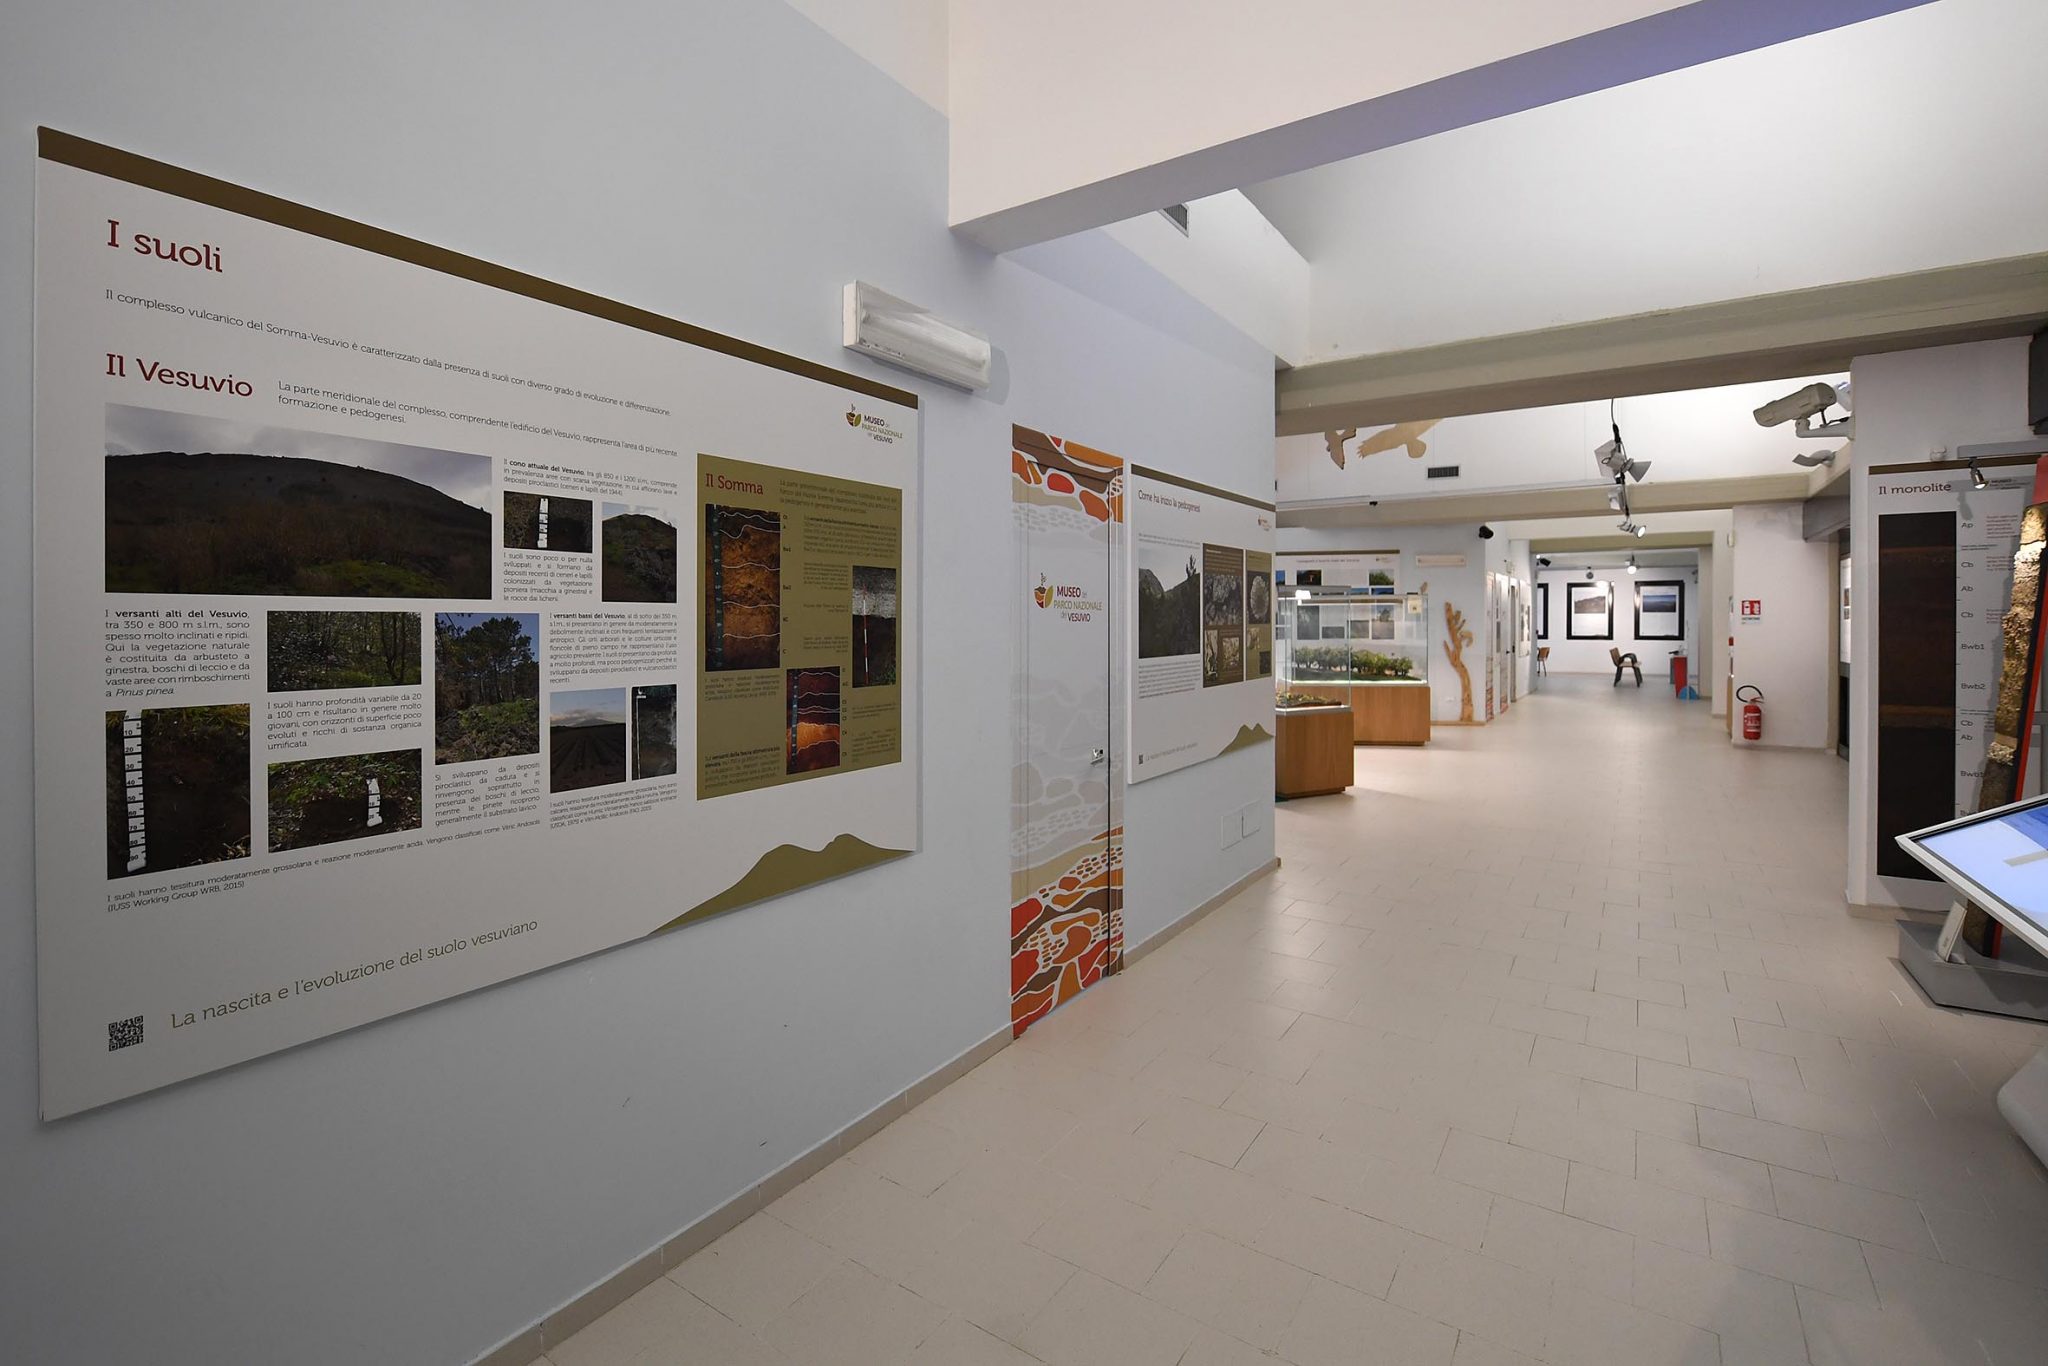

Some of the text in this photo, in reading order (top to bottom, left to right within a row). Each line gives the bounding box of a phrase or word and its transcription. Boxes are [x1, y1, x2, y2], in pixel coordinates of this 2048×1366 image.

[107, 220, 223, 273] I suoli
[106, 289, 113, 300] Il
[118, 294, 184, 314] complesso
[189, 309, 243, 326] vulcanico
[247, 320, 263, 330] del
[267, 324, 349, 348] Somma-Vesuvio
[352, 342, 358, 351] è
[361, 346, 420, 363] caratterizzato
[423, 358, 442, 368] dalla
[445, 363, 480, 376] presenza
[492, 374, 508, 382] suoli
[528, 380, 552, 391] diverso
[554, 387, 574, 396] grado
[584, 393, 618, 405] evoluzione
[106, 353, 253, 398] Il Vesuvio
[278, 395, 338, 412] formazione
[279, 381, 290, 391] La
[294, 386, 320, 396] parte
[323, 391, 380, 406] meridionale
[383, 400, 396, 409] del
[450, 413, 508, 428] comprendente
[511, 422, 540, 433] l'edificio
[583, 436, 620, 447] rappresenta
[864, 415, 886, 426] MUSEO
[706, 473, 764, 494] Il Somma
[1878, 483, 1952, 494] Il monolite
[1056, 586, 1081, 598] MUSEO
[1054, 600, 1102, 611] PARCO NAZIONALE
[1068, 612, 1090, 622] VESUVIO
[125, 620, 143, 629] 350
[159, 620, 178, 628] 800
[105, 643, 124, 652] Qui
[147, 644, 206, 652] vegetazione
[105, 676, 132, 685] vaste
[179, 674, 250, 682] rimboschimenti
[273, 701, 293, 709] suoli
[326, 697, 366, 706] profondità
[278, 710, 292, 719] 100
[371, 705, 397, 714] genere
[321, 717, 355, 725] orizzonti
[367, 714, 401, 722] superficie
[267, 731, 296, 740] evoluti
[114, 891, 135, 901] suoli
[139, 887, 167, 896] hanno
[171, 880, 204, 890] tessitura
[208, 869, 270, 883] moderatamente
[273, 861, 312, 873] grossolana
[108, 901, 130, 912] (IUSS
[134, 896, 169, 907] Working
[172, 891, 198, 900] Group
[224, 877, 245, 890] 2015)
[172, 922, 538, 1028] La nascita e l'evoluzione del suolo vesuviano
